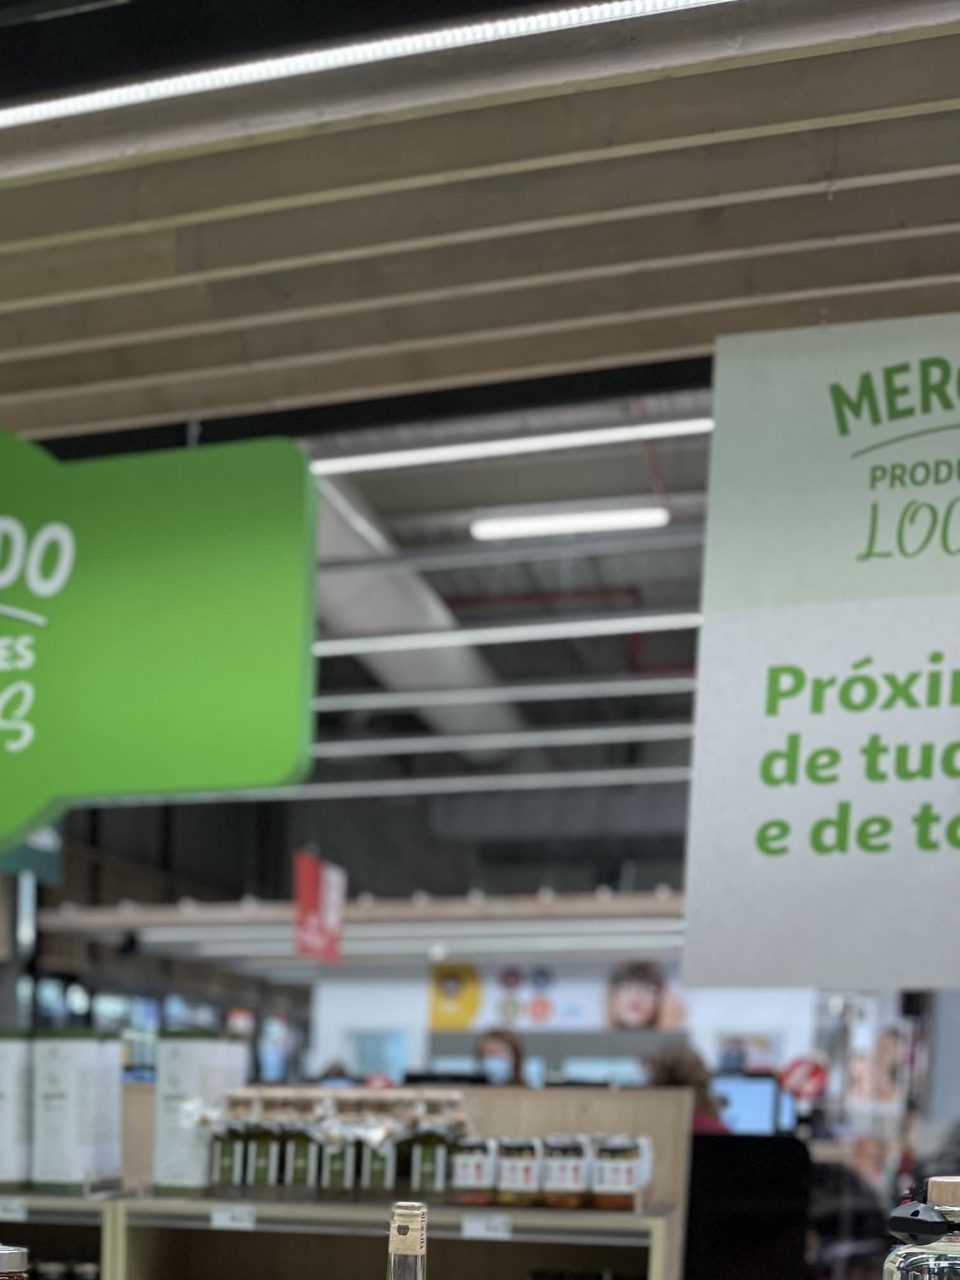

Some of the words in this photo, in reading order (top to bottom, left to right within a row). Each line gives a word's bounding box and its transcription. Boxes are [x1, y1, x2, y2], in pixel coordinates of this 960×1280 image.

[830, 356, 960, 437] MER
[869, 458, 960, 491] PROD
[765, 651, 960, 717] Próxi
[759, 732, 842, 787] de
[755, 818, 791, 858] e
[810, 800, 892, 855] de
